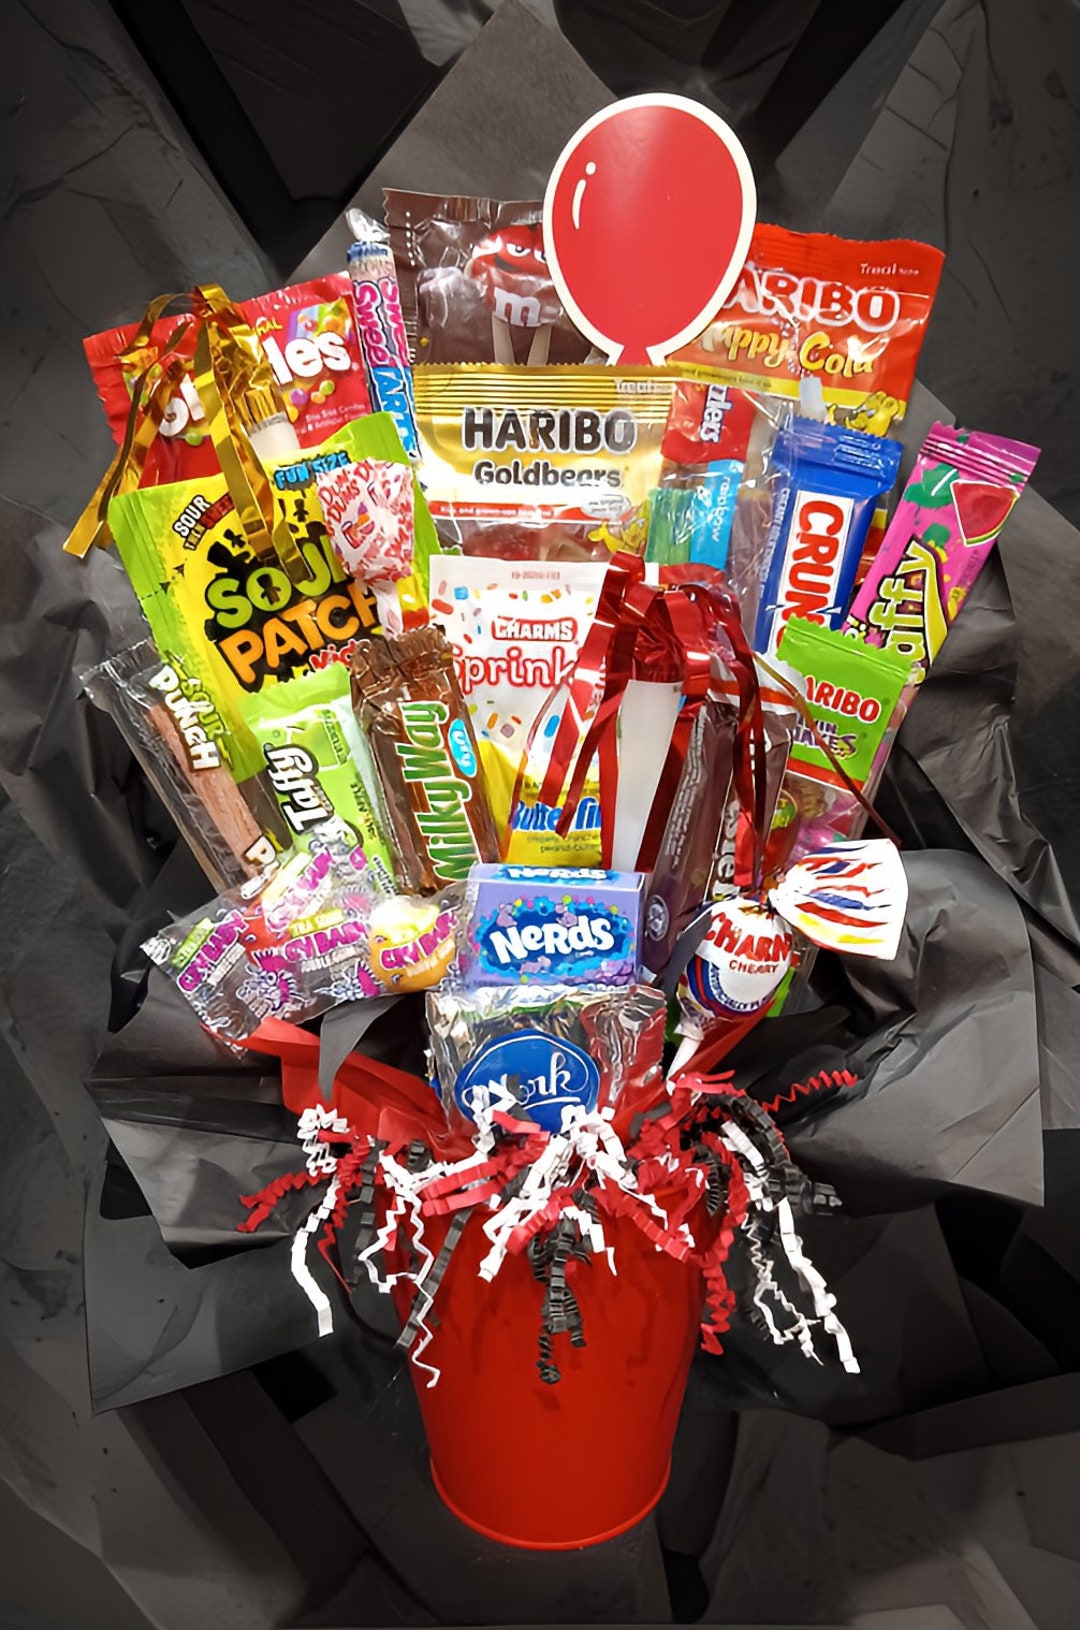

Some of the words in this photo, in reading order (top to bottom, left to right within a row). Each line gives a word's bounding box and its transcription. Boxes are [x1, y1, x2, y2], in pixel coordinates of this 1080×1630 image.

[724, 264, 899, 332] ARIBO
[463, 407, 637, 454] HARIBO
[274, 462, 311, 491] FUN
[473, 460, 622, 487] Goldbears
[173, 495, 211, 537] SOUR
[777, 500, 844, 645] CRUN
[497, 617, 574, 641] CHARMS
[868, 540, 948, 684] affy
[451, 645, 578, 695] prink
[149, 664, 222, 771] PUNCH
[180, 676, 228, 738] SOUR
[804, 675, 882, 724] RIBO
[264, 743, 336, 836] Taffy
[704, 911, 794, 962] CHARM
